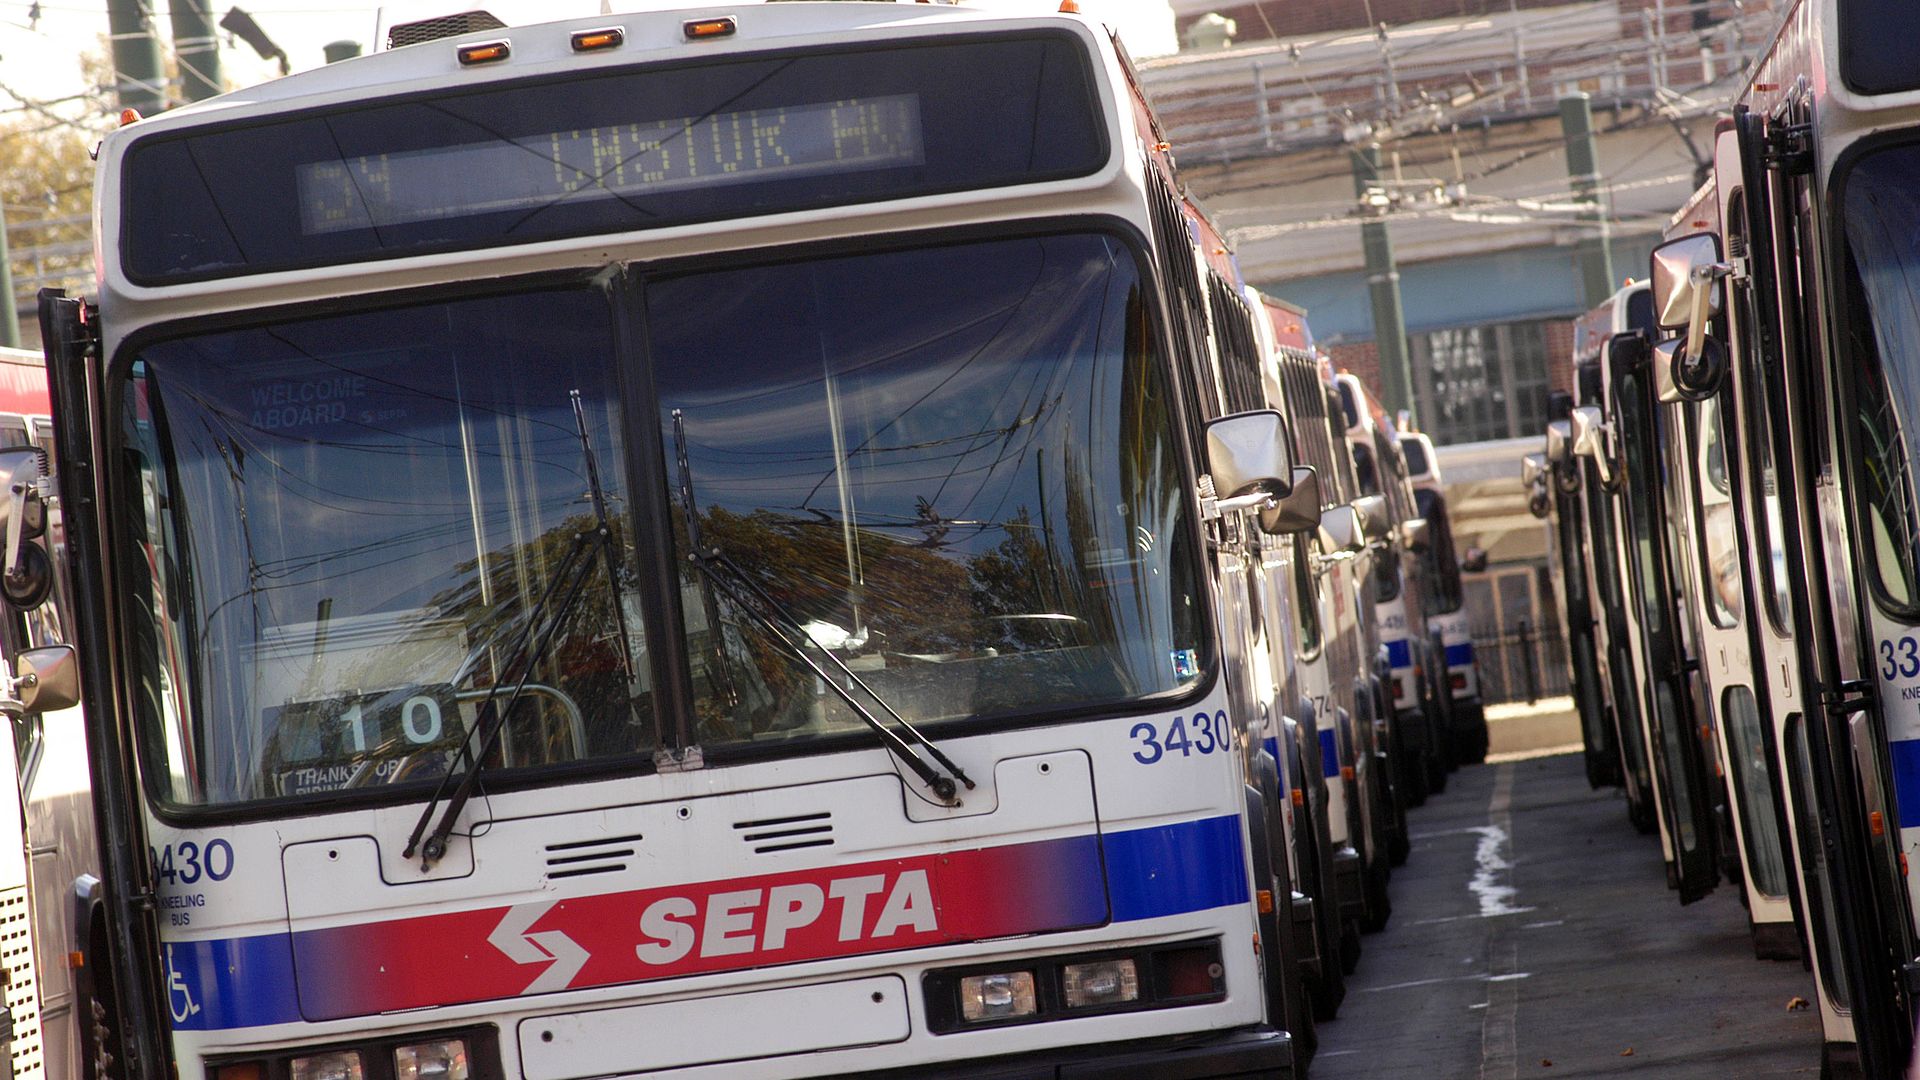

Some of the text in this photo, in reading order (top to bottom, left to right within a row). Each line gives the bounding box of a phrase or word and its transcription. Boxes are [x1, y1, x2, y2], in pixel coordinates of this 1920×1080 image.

[251, 376, 366, 406] WELCOME
[251, 401, 347, 430] ABOARD
[1129, 709, 1231, 765] 3430
[161, 893, 205, 910] KNEELING
[172, 912, 190, 926] BUS
[635, 868, 939, 966] SEPTA
